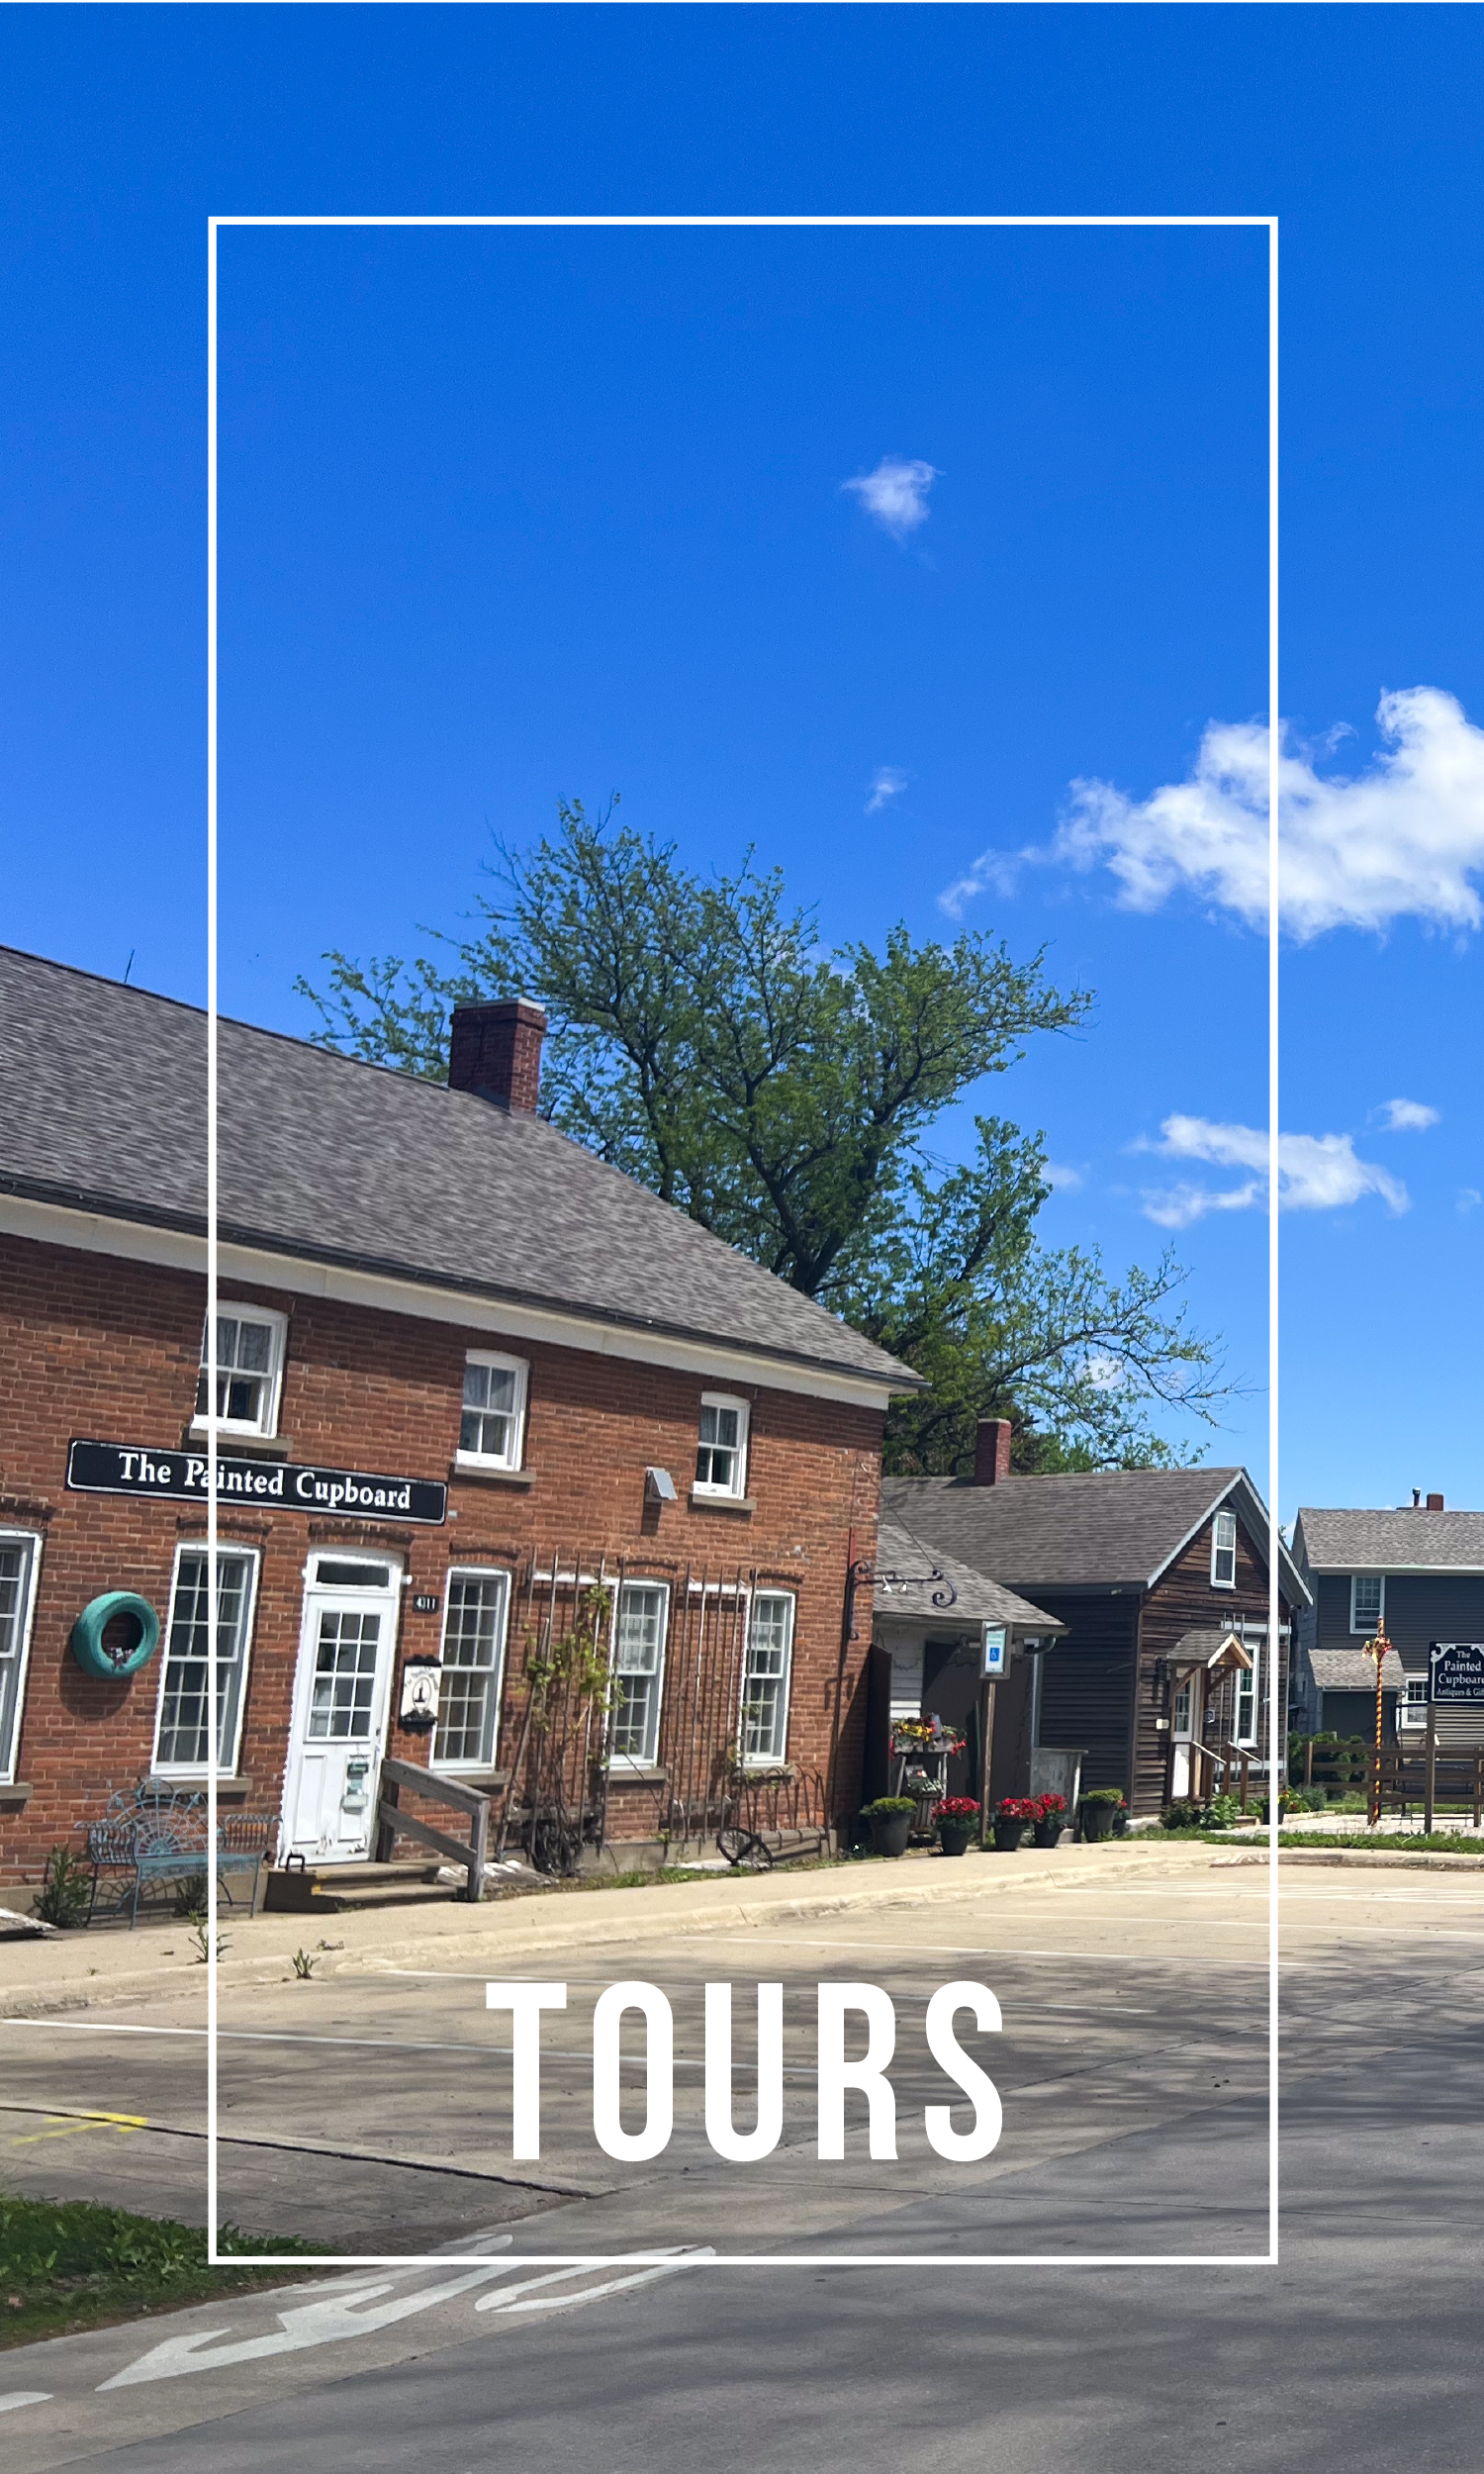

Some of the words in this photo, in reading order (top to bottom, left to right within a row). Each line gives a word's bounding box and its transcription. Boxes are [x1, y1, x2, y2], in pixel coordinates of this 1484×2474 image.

[119, 1452, 171, 1483] The
[297, 1472, 412, 1509] Cupboard
[1444, 1661, 1482, 1671] Painted
